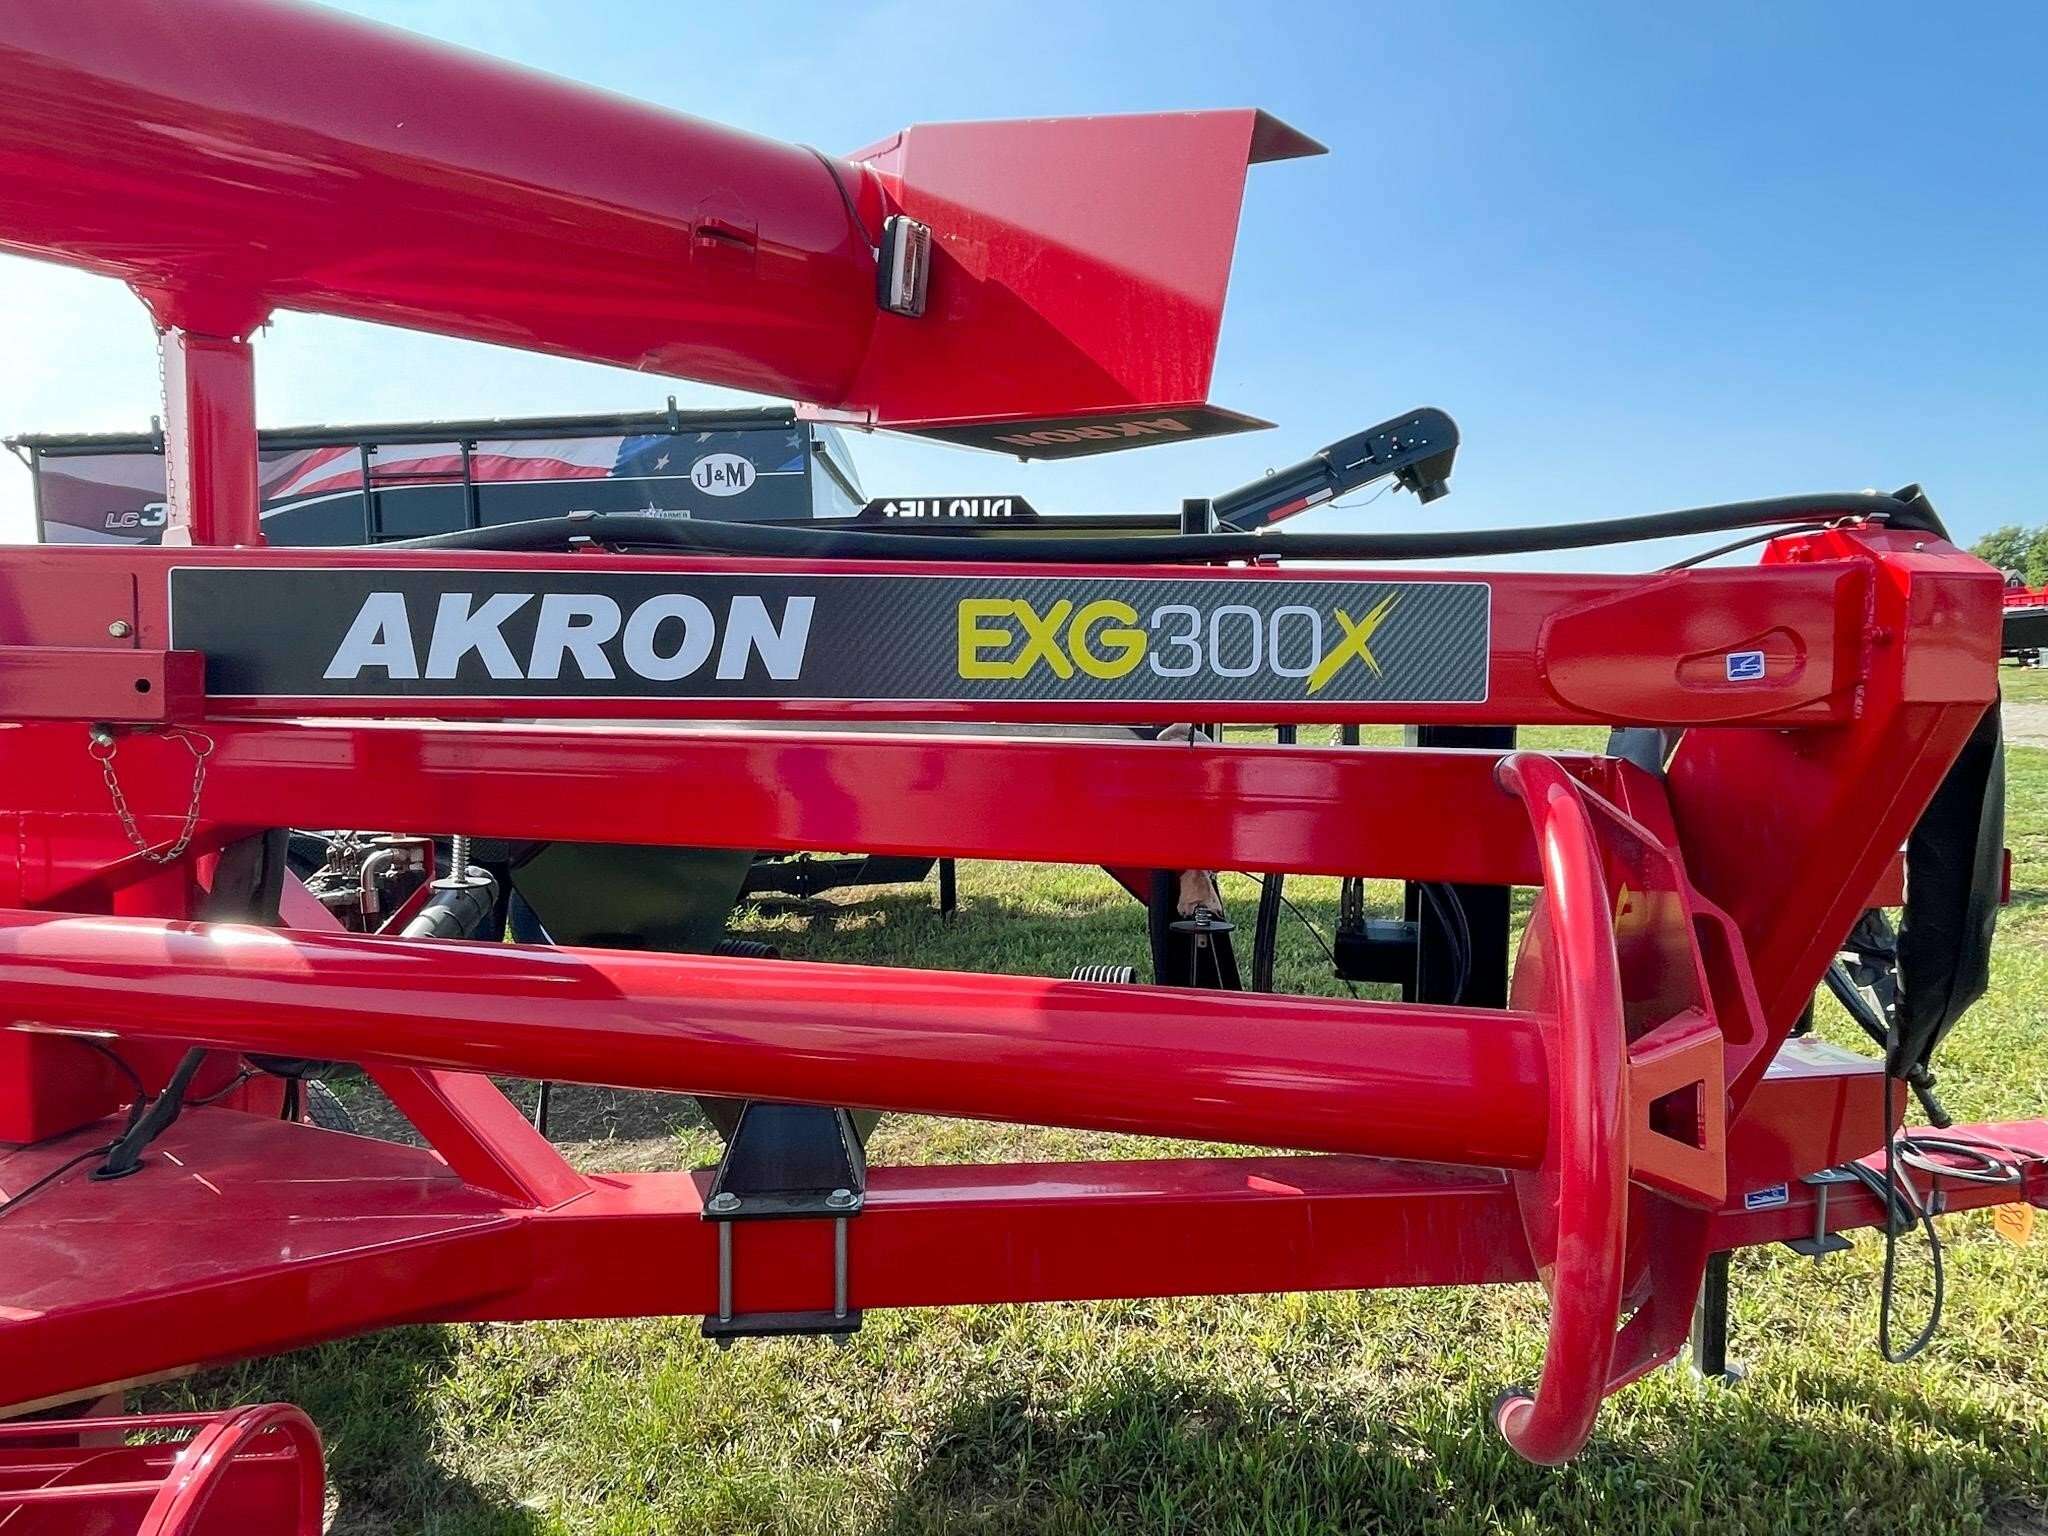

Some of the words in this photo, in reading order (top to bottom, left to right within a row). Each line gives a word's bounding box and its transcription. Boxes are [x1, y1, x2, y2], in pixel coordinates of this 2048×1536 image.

[993, 418, 1192, 447] AKRON
[696, 462, 748, 488] J&M
[322, 592, 817, 681] AKRON
[957, 590, 1408, 696] EXG300X
